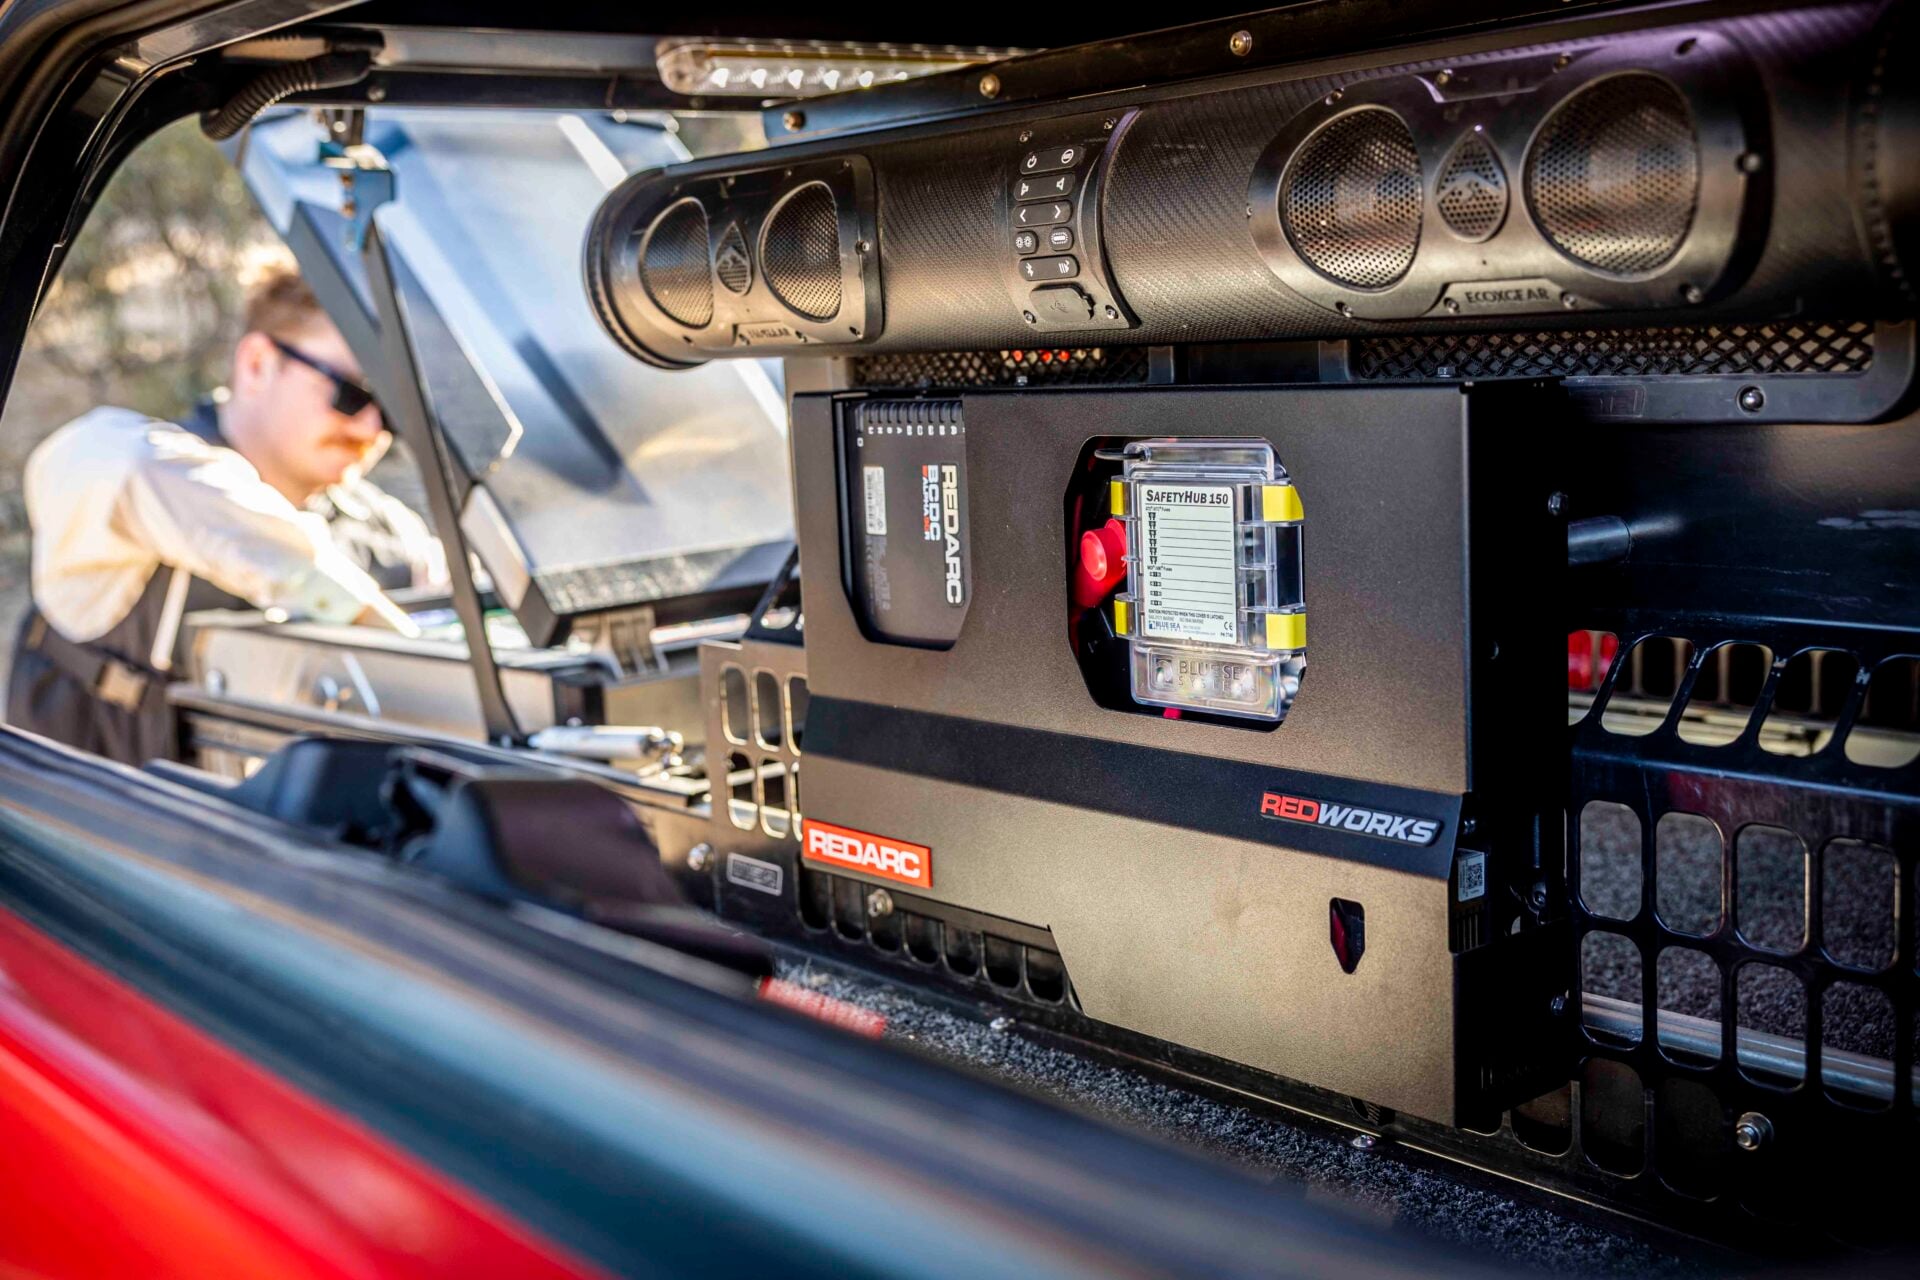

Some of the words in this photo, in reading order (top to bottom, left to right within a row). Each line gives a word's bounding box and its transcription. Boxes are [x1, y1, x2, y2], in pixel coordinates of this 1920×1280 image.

[1465, 287, 1549, 304] ECOXGEAR
[927, 464, 941, 542] BCDC
[1209, 493, 1229, 505] 150
[940, 464, 962, 604] REDARC
[1261, 792, 1437, 843] REDWORKS
[808, 828, 920, 878] REDARC
